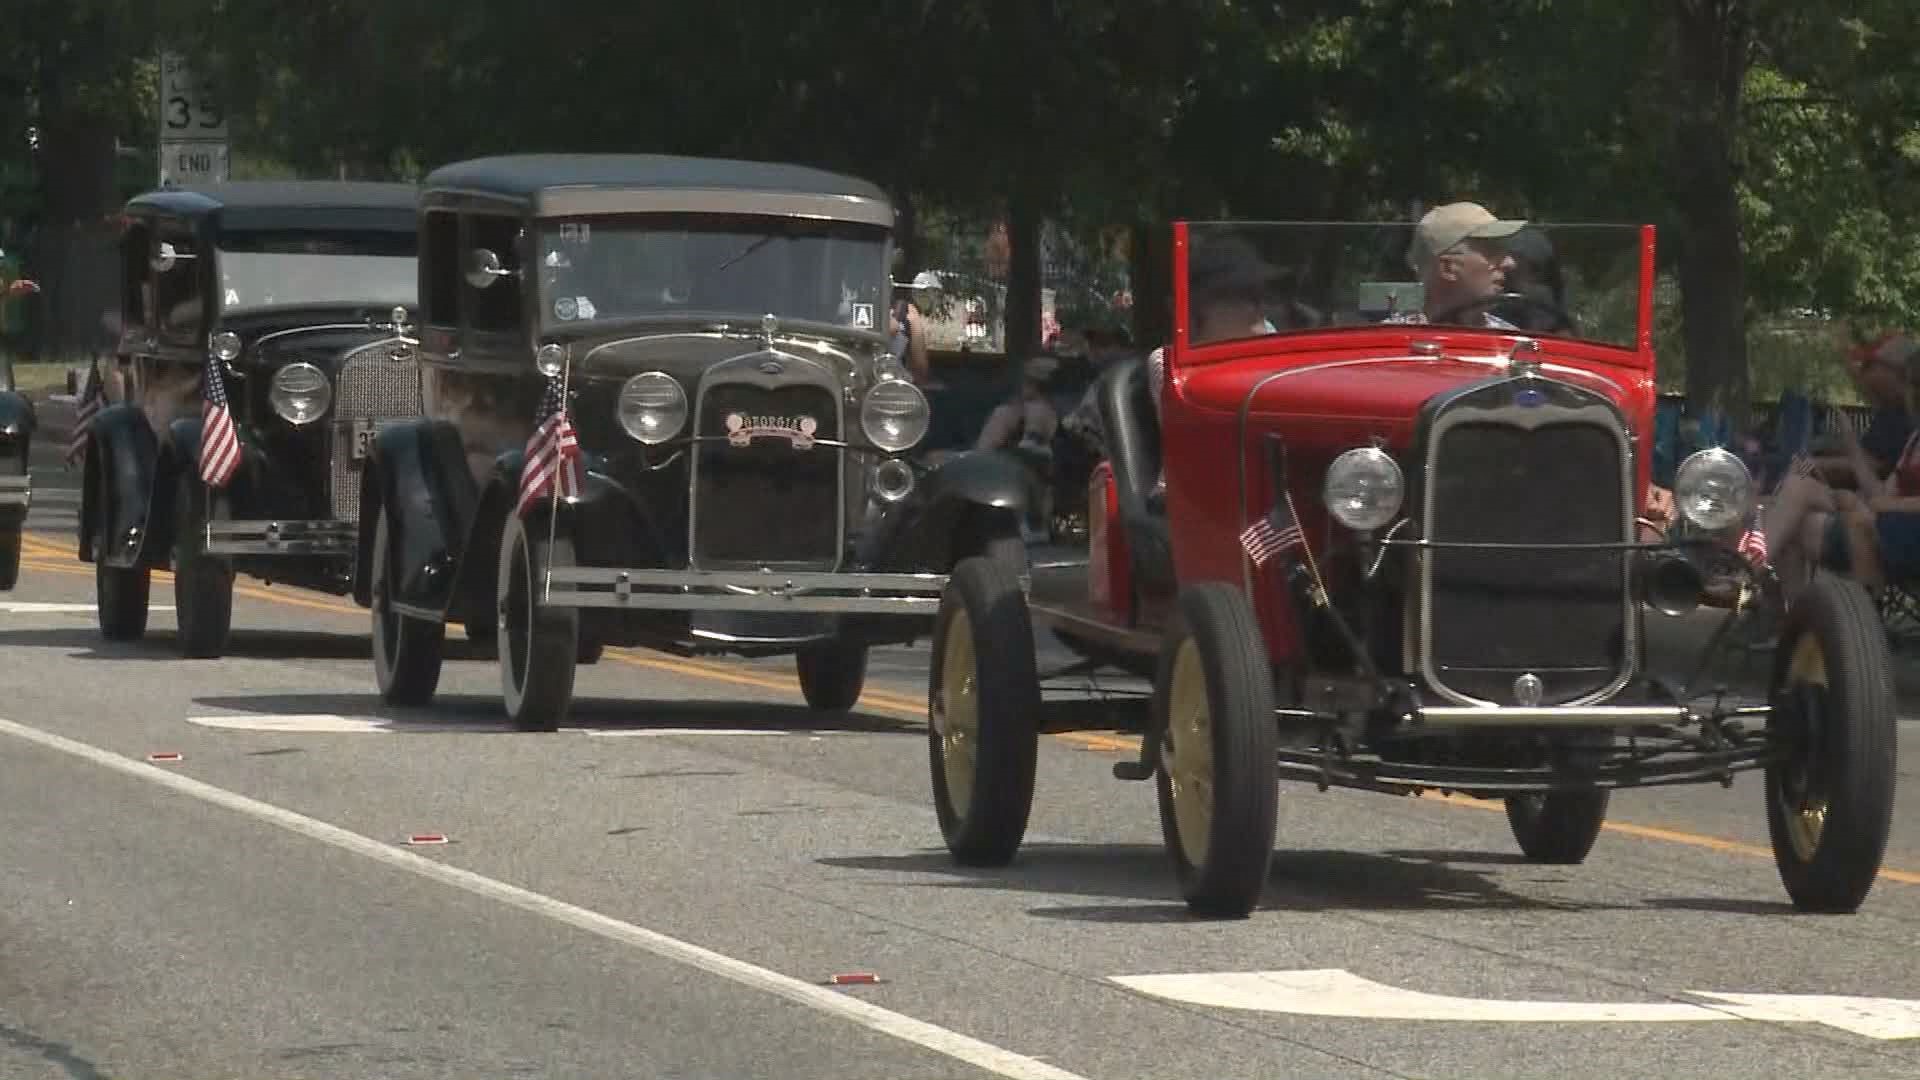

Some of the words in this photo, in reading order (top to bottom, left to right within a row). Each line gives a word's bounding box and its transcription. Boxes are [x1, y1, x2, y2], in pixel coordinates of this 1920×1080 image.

[167, 95, 223, 129] 35
[179, 153, 210, 172] END
[856, 307, 870, 325] A
[743, 415, 800, 432] GEORGIA
